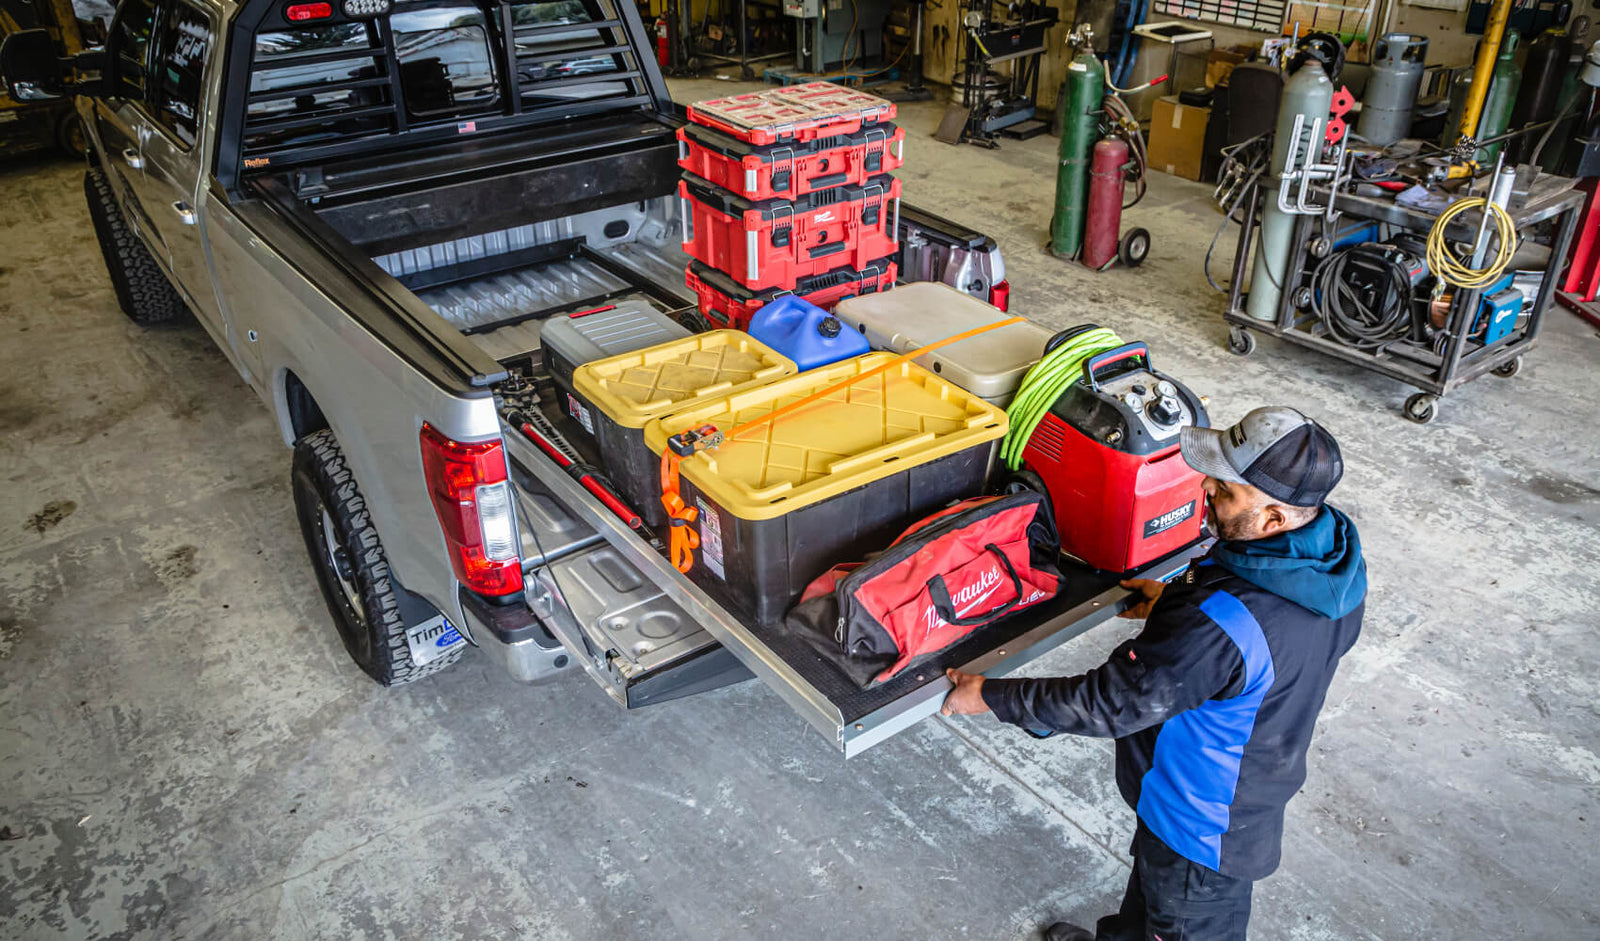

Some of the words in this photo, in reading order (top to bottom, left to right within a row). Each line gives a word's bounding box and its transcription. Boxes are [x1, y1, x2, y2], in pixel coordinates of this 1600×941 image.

[244, 158, 270, 168] Reflex
[1160, 502, 1192, 526] HUSKY
[922, 565, 1000, 641] Mwaukee
